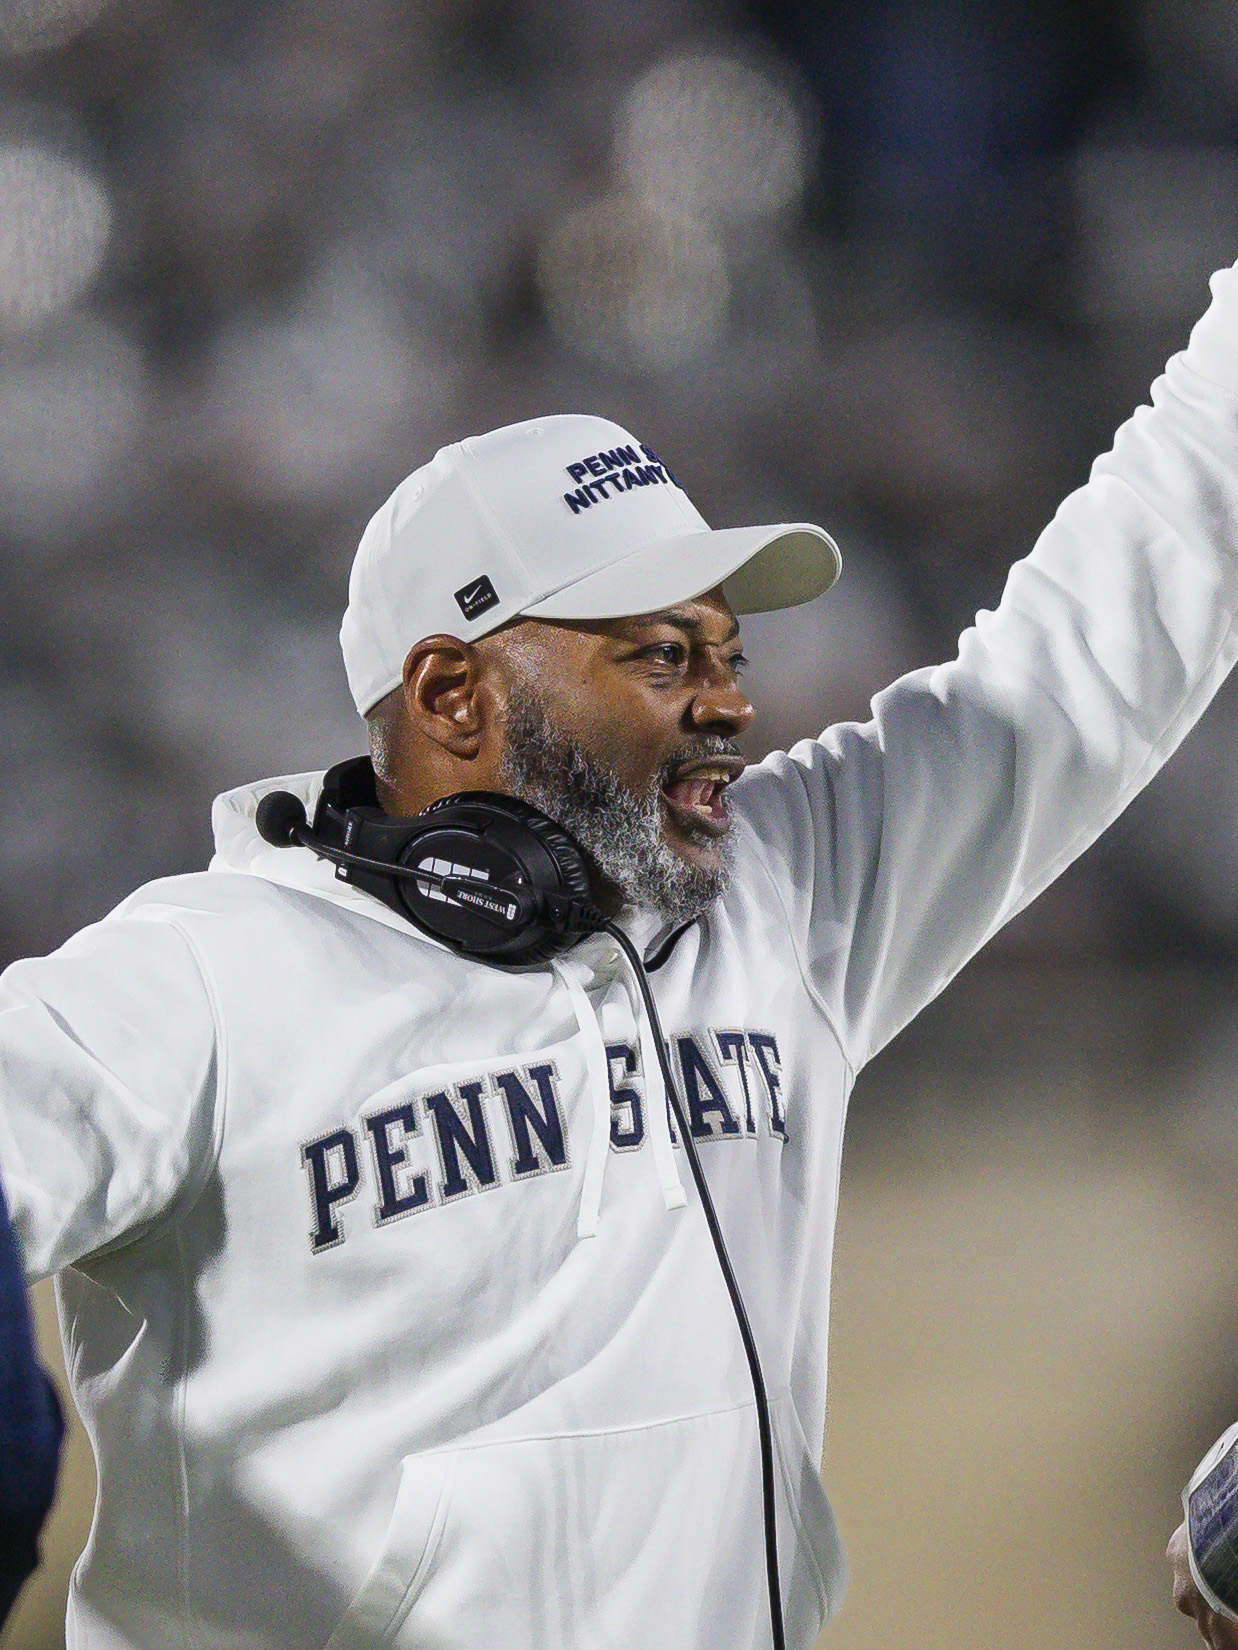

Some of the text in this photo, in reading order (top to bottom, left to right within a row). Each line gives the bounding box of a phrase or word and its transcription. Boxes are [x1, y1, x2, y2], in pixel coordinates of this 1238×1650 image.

[565, 444, 641, 484] PENN
[563, 465, 668, 515] NITTANY
[456, 889, 485, 906] SHORE
[484, 900, 505, 915] WEST
[300, 1026, 789, 1255] PENN SATE
